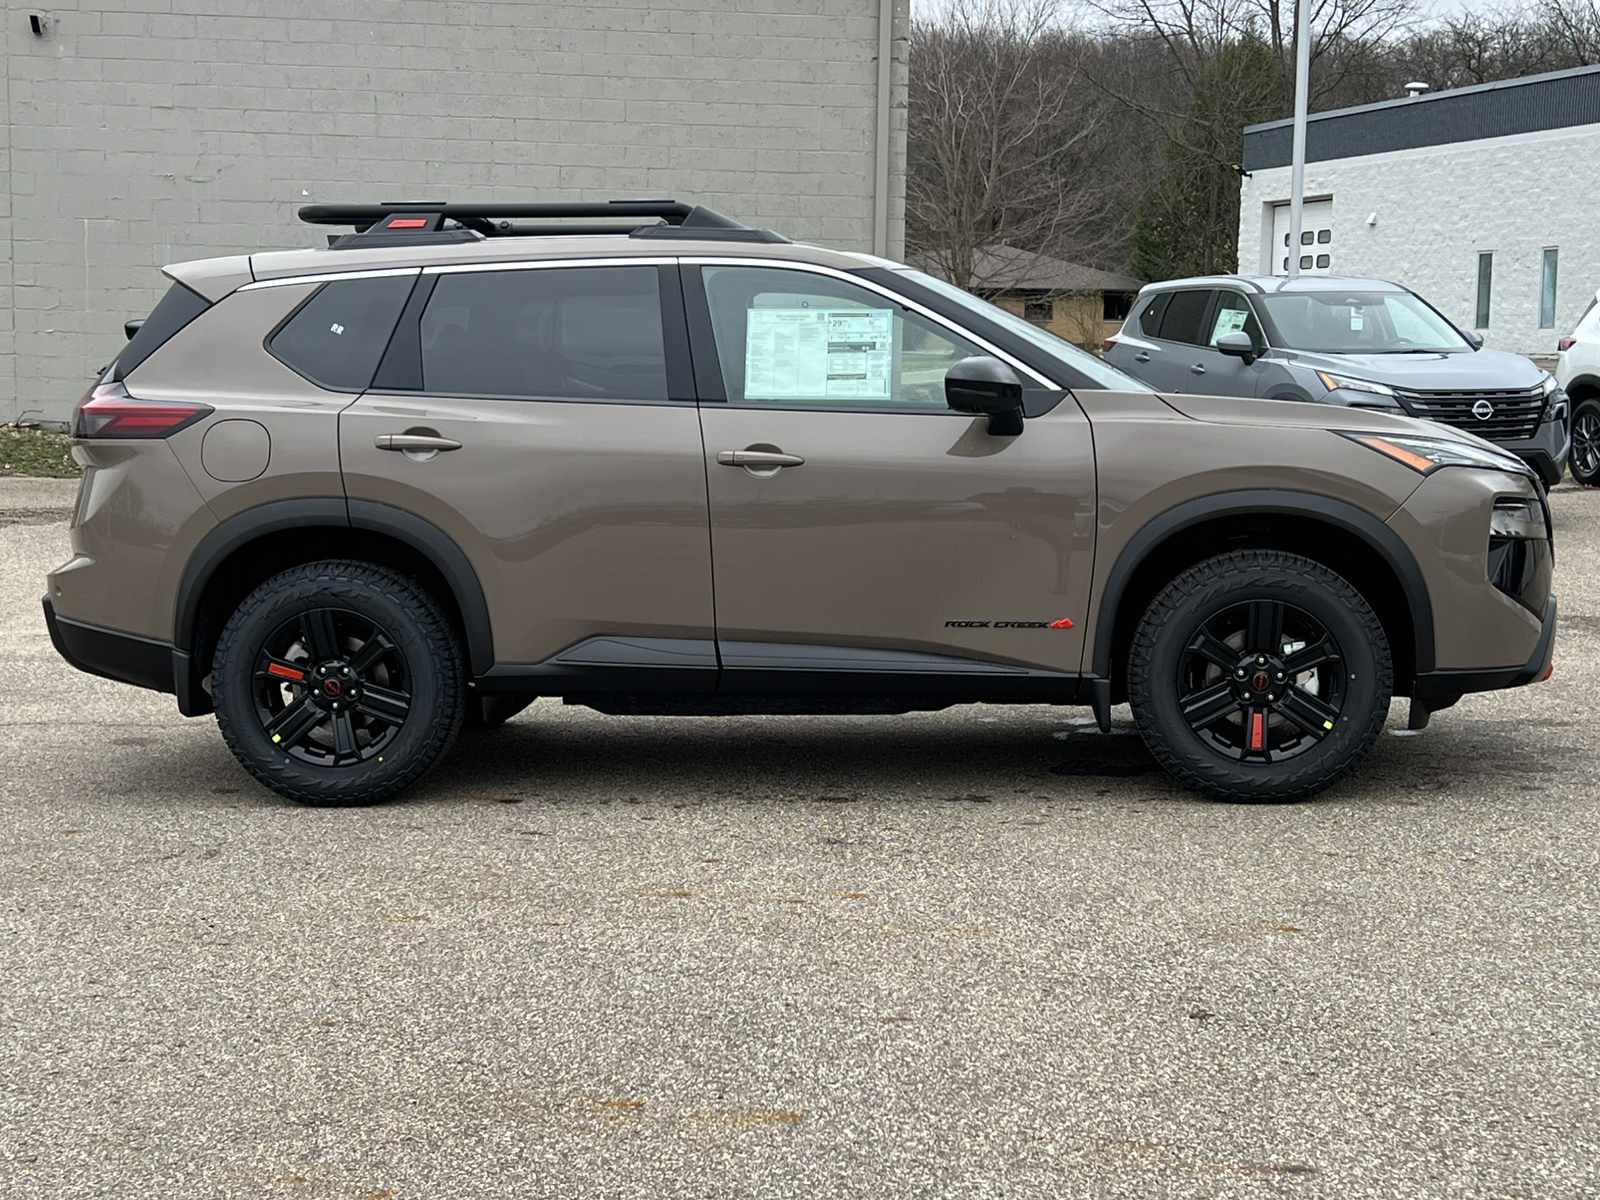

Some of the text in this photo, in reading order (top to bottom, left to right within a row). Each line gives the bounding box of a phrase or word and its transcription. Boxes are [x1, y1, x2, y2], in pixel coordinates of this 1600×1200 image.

[832, 319, 842, 328] 29
[330, 323, 344, 335] RR
[945, 620, 1050, 629] ROCK CREEK
